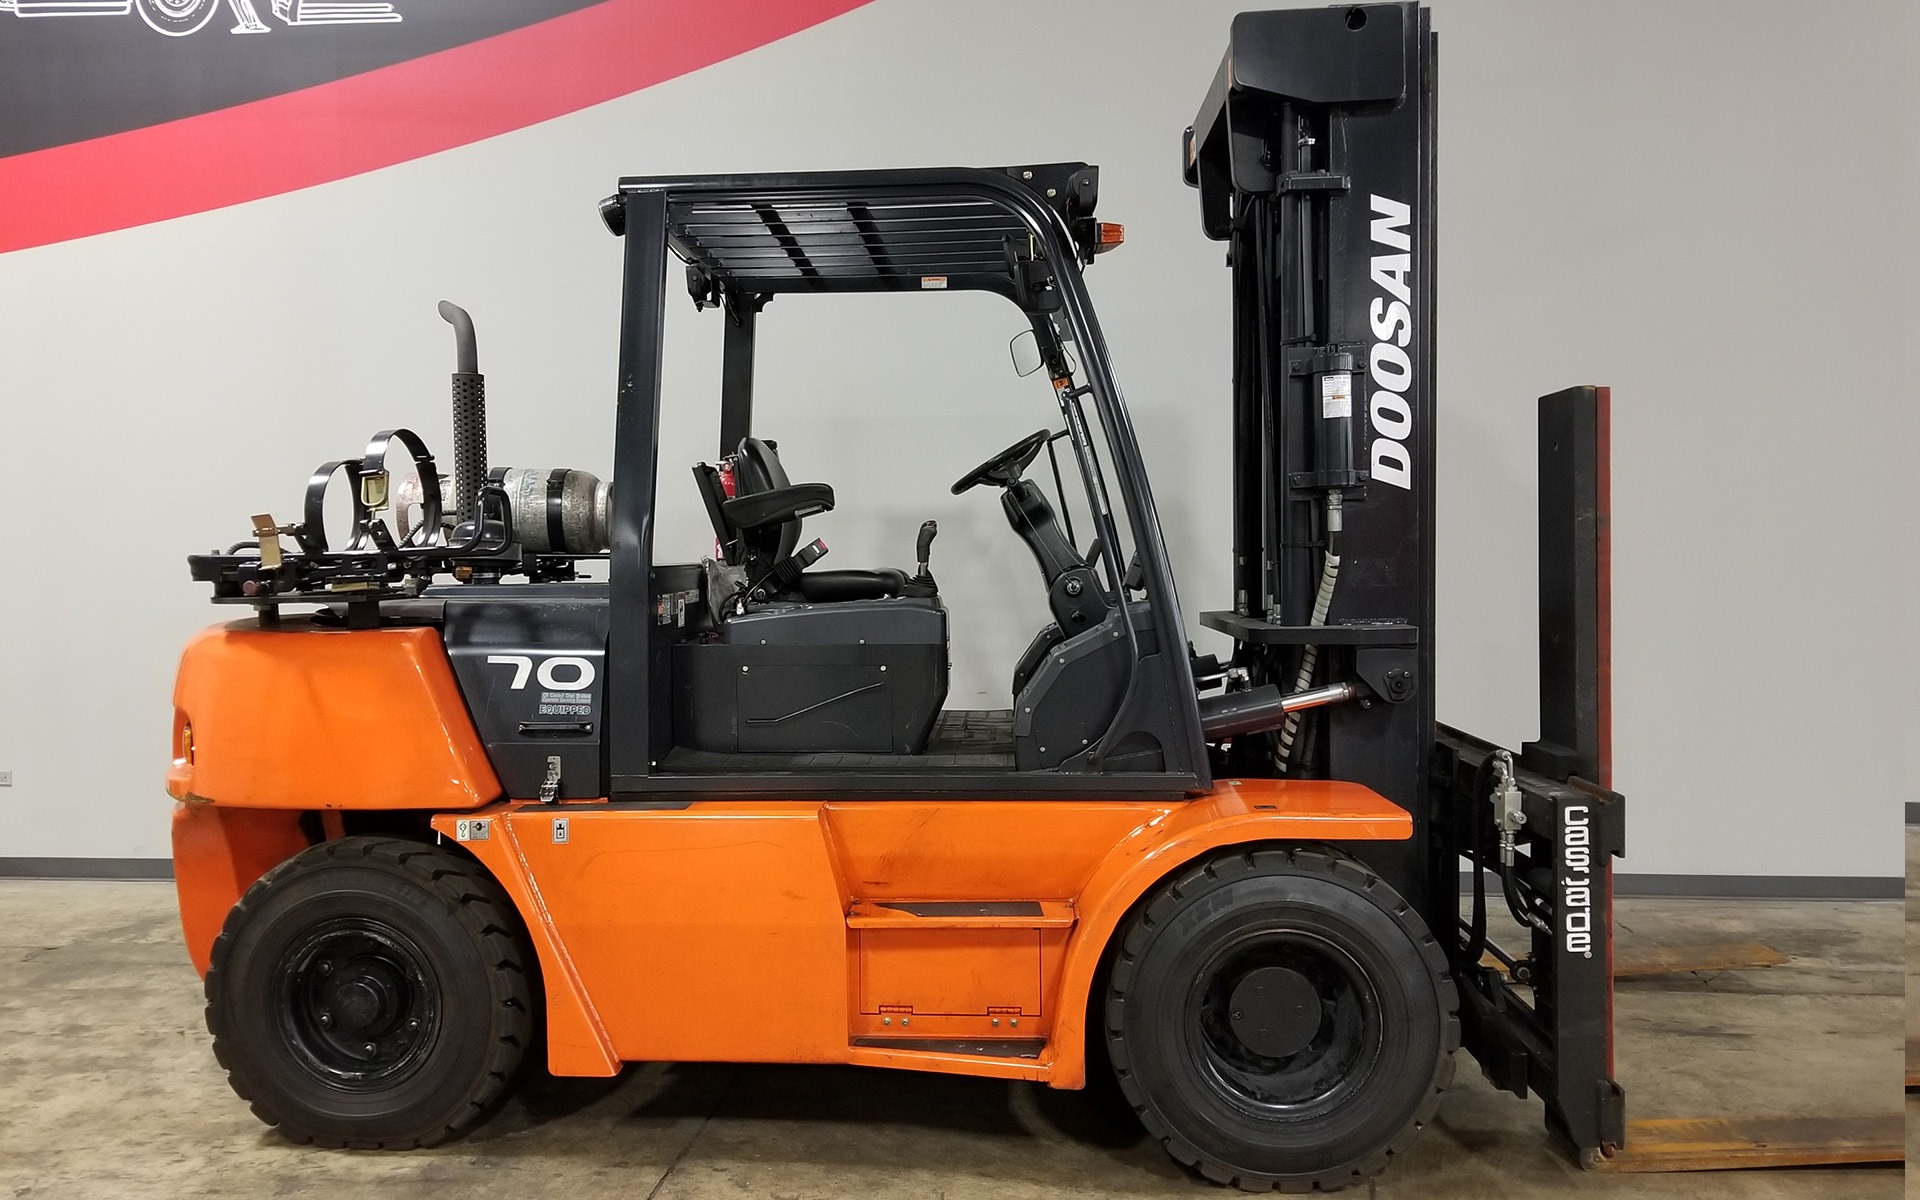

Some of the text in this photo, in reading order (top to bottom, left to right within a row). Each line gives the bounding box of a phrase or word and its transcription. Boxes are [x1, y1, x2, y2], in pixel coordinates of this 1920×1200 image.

[1370, 194, 1412, 491] DOOSAN
[487, 655, 596, 691] 70
[538, 703, 592, 717] EQUIPPED
